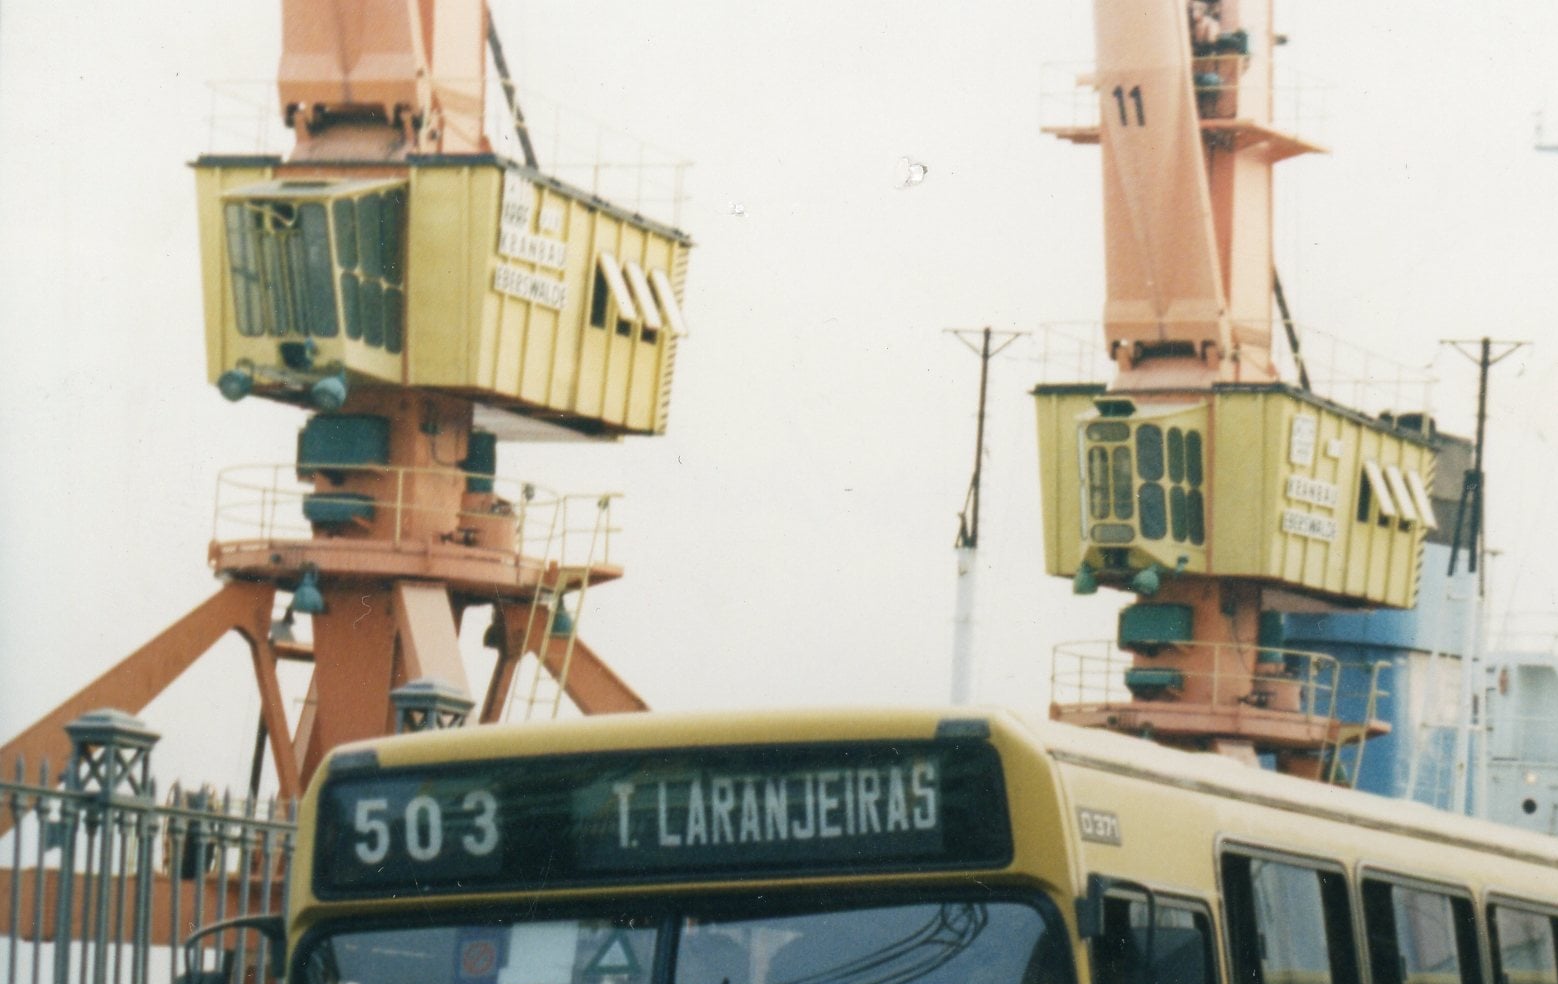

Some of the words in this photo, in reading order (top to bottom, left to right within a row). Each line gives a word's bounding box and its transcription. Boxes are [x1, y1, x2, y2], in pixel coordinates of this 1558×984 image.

[1111, 84, 1145, 127] 11
[353, 790, 498, 866] 503
[657, 762, 937, 847] LARANJEIRAS
